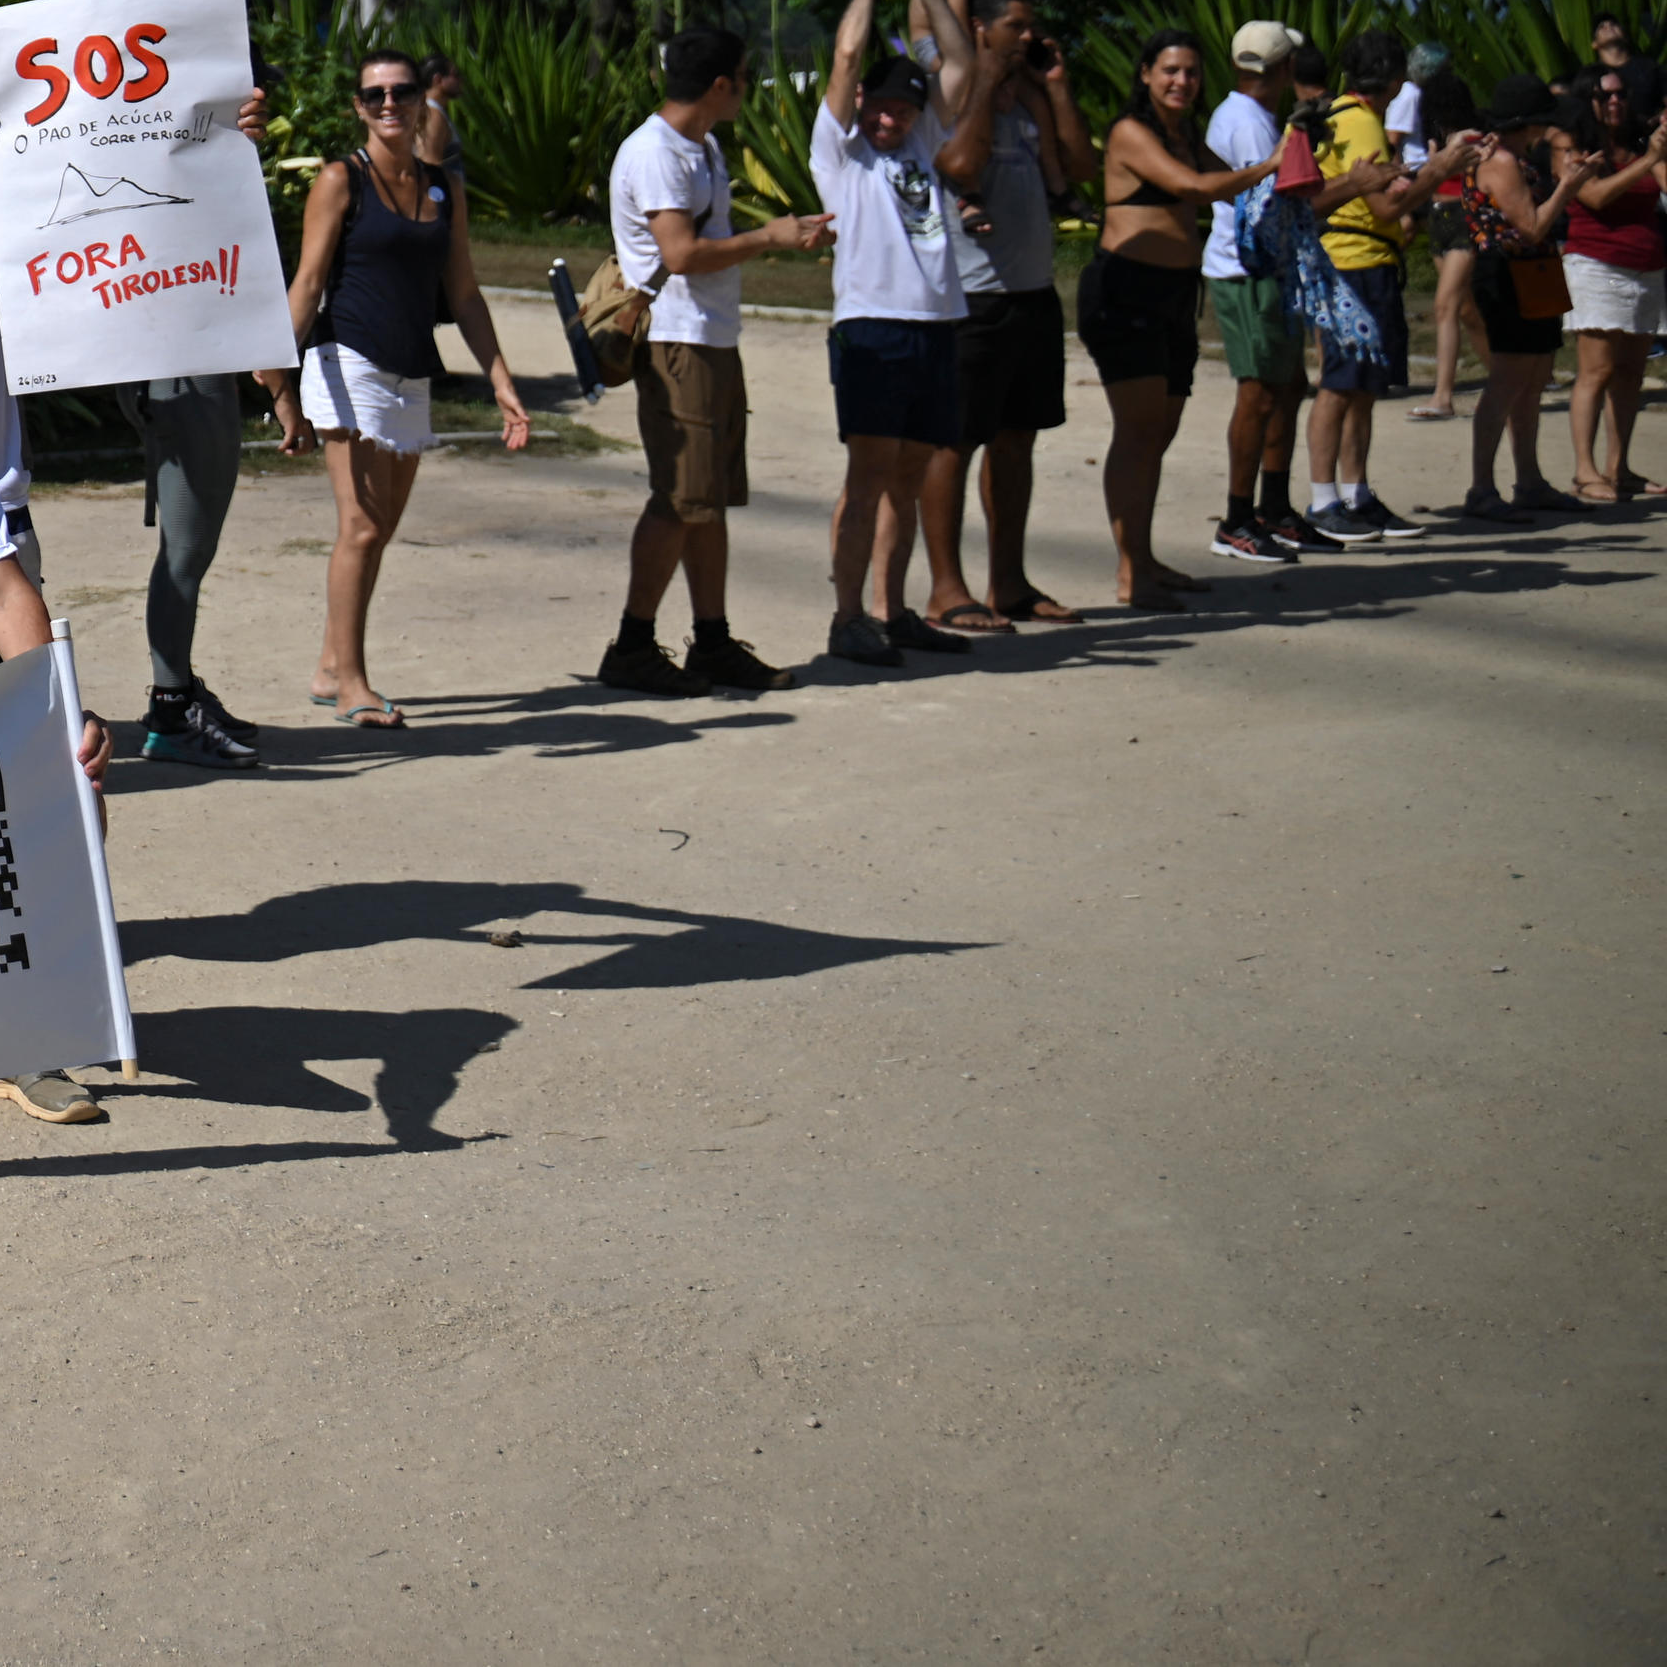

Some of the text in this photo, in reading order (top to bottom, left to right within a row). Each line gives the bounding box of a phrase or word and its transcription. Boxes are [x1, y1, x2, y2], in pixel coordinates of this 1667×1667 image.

[14, 22, 170, 128] SOS
[14, 134, 28, 154] O
[79, 121, 98, 137] DE
[90, 135, 136, 147] CORRE
[26, 233, 146, 296] FORA
